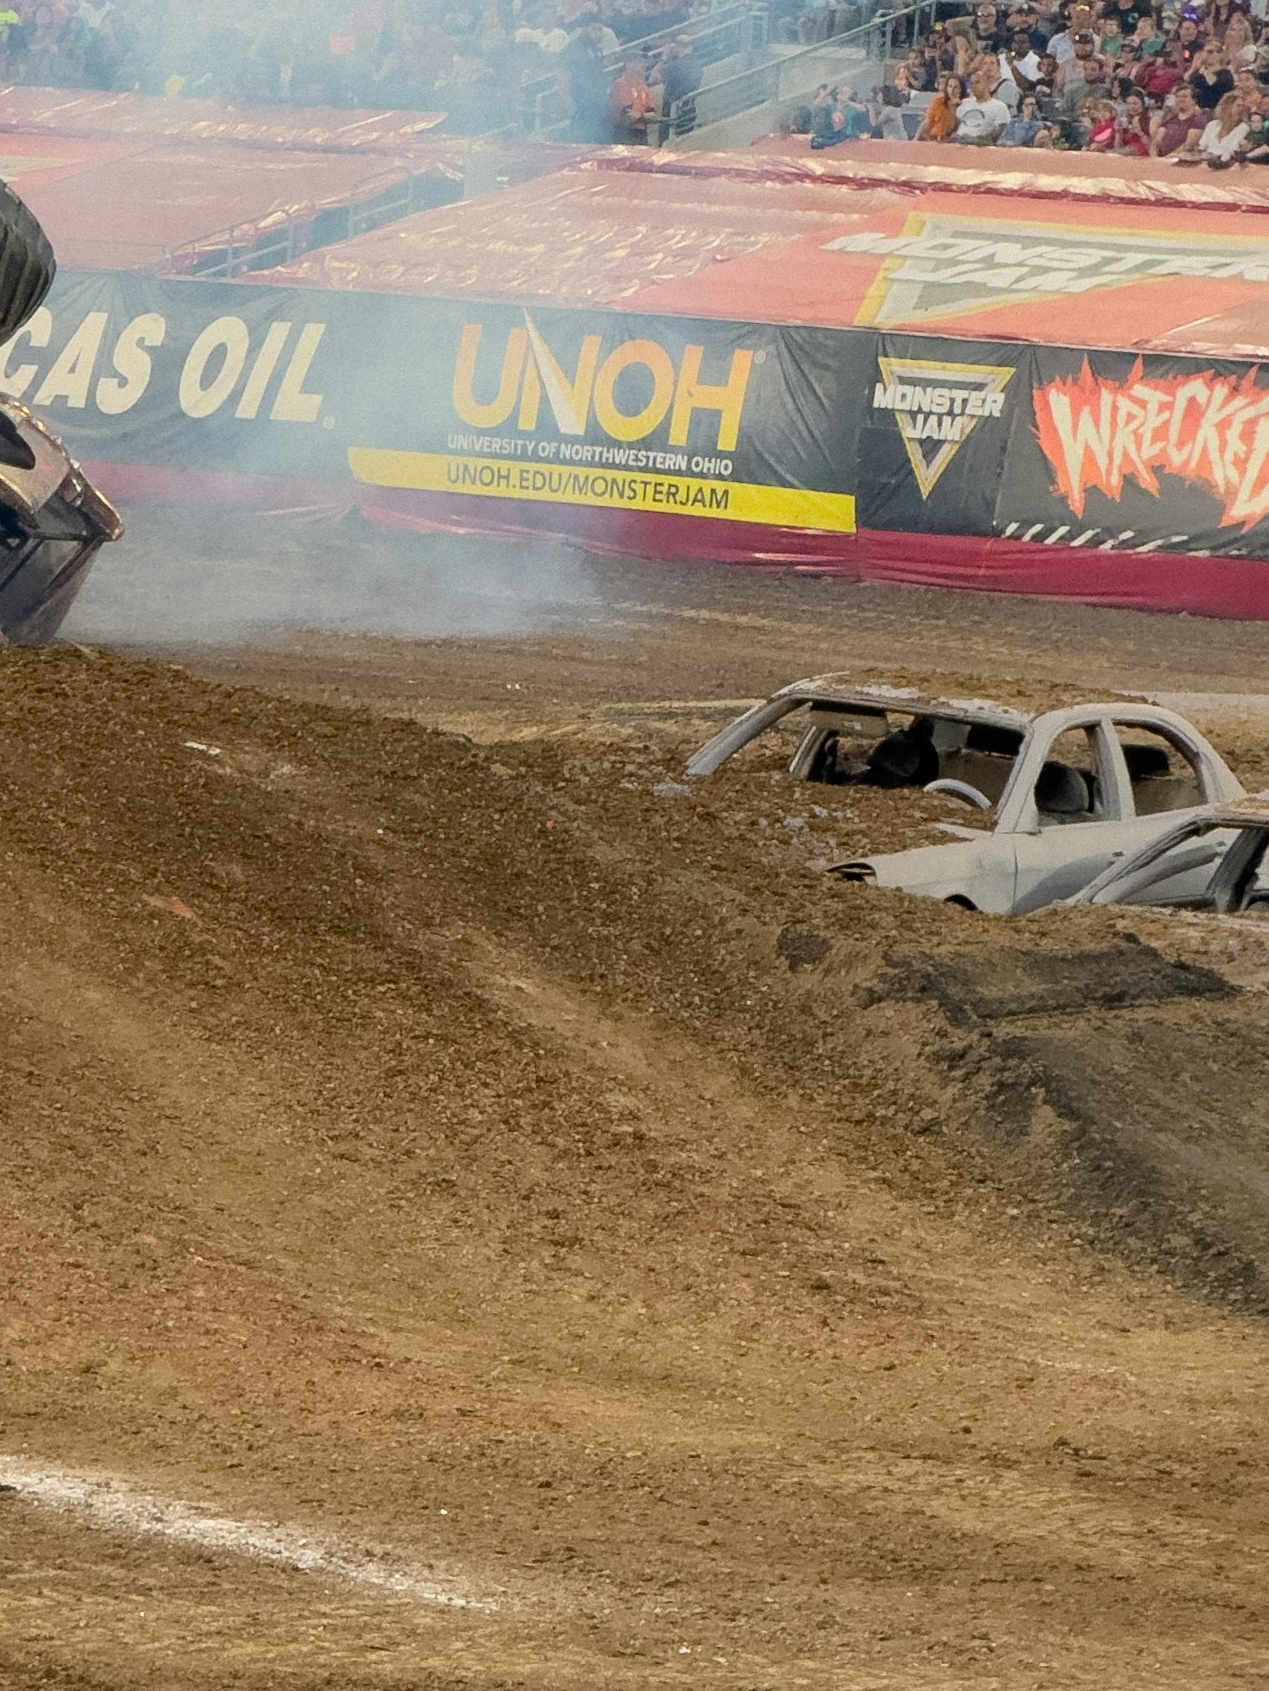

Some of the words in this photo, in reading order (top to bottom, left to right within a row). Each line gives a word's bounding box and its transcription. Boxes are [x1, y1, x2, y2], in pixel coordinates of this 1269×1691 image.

[179, 316, 326, 423] OIL
[452, 307, 754, 452] UNOH
[873, 382, 1005, 418] MONSTER
[905, 413, 965, 442] JAM
[447, 433, 536, 457] UNIVERSITY
[538, 439, 559, 458] OF
[560, 439, 688, 472] NORTHWESTERN
[691, 456, 733, 477] OHIO
[446, 462, 730, 510] UNOH.EDU/MONSTERJAM
